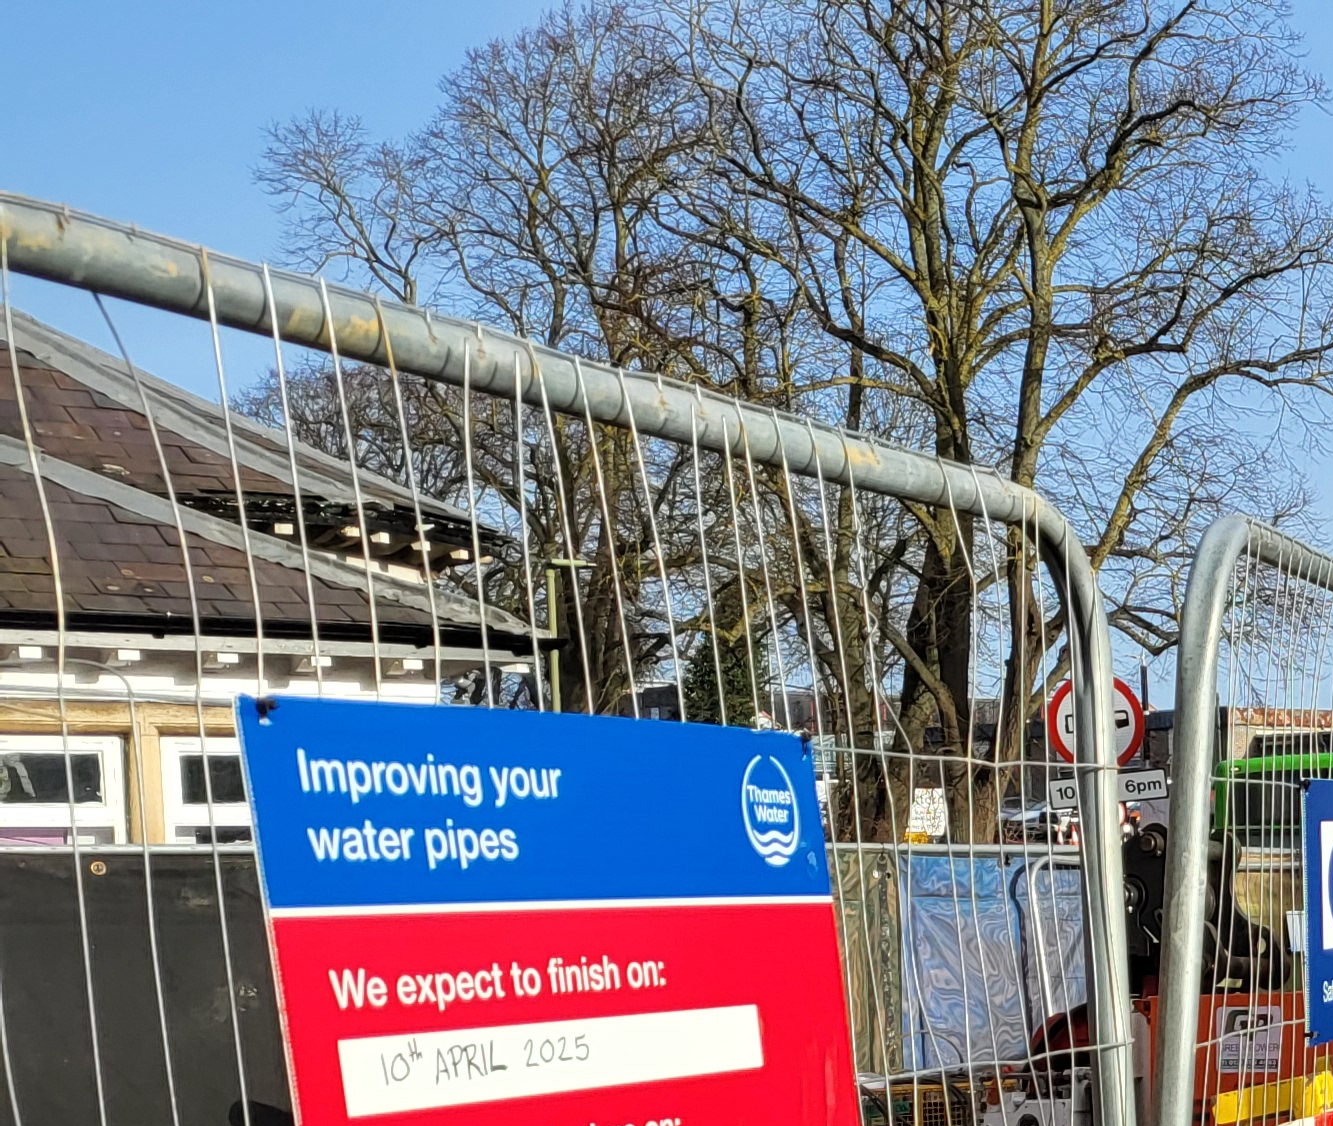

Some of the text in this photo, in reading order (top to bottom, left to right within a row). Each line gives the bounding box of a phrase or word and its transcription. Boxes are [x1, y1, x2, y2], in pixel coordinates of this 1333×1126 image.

[297, 748, 561, 806] Improving your
[747, 784, 793, 806] Thames
[1125, 777, 1162, 794] 6pm
[753, 804, 790, 825] Water
[308, 820, 519, 869] water pipes
[329, 955, 667, 1010] We expect to finish on:
[380, 1033, 590, 1086] 10th APRIL 2025
